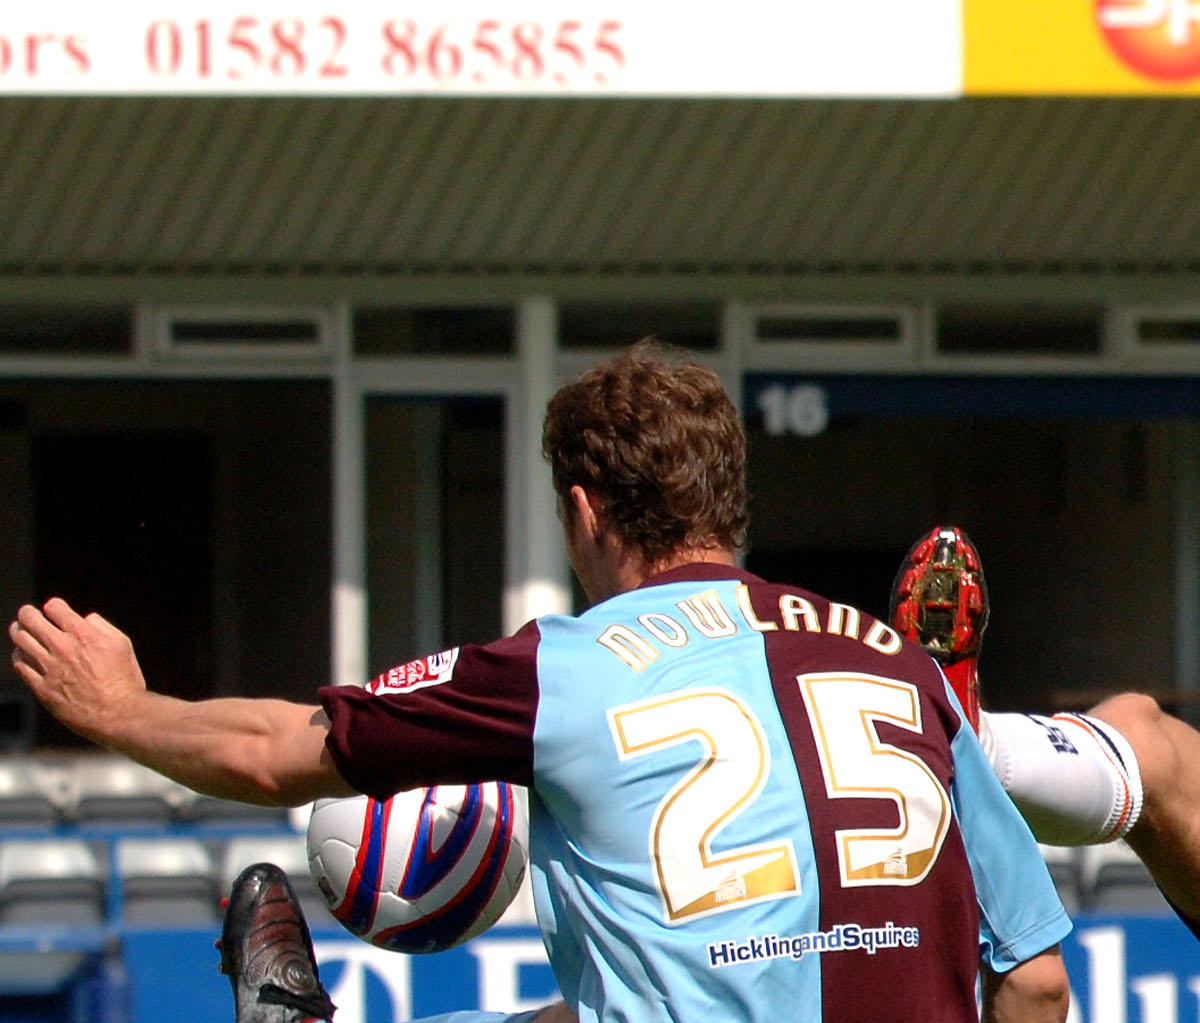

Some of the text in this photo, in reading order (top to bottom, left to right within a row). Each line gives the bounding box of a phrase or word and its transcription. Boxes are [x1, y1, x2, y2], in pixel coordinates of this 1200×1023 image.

[144, 16, 350, 79] 01582
[380, 17, 628, 88] 865855
[757, 384, 828, 437] 16
[596, 584, 902, 672] NOWLAND
[606, 671, 953, 926] 25
[708, 922, 920, 969] HicklingandSquires
